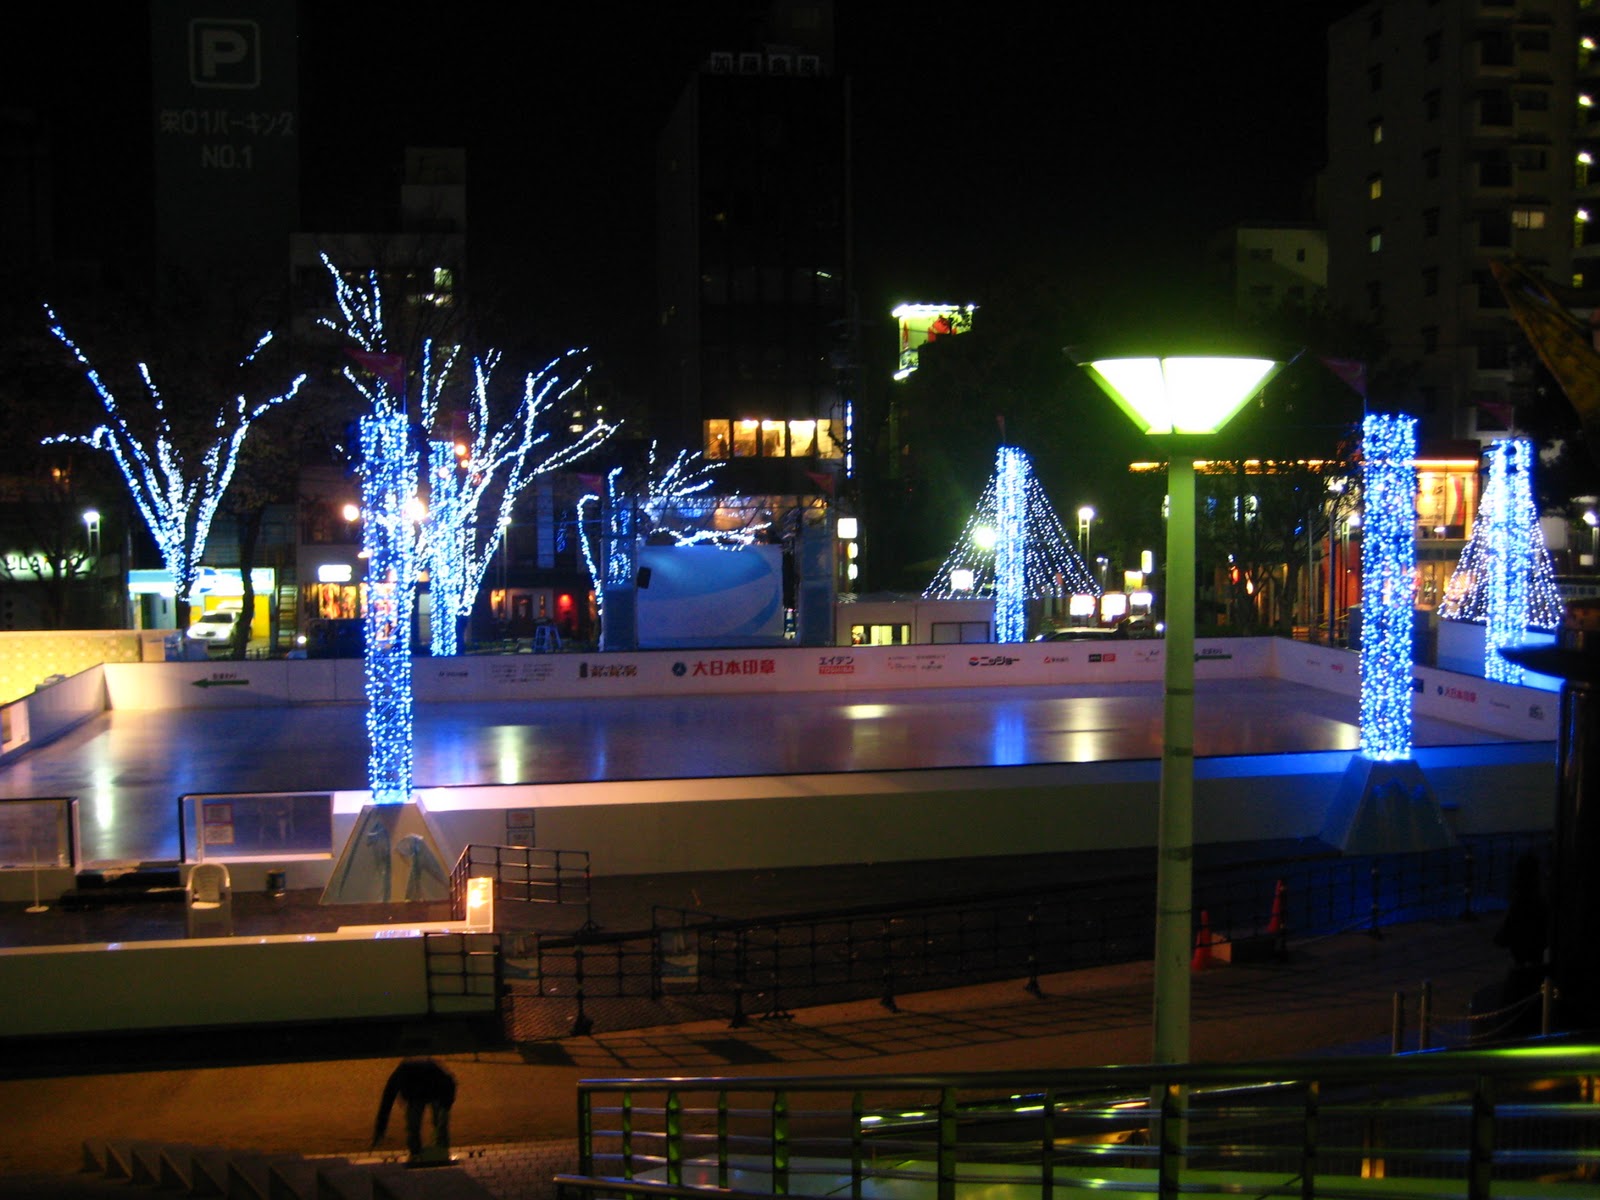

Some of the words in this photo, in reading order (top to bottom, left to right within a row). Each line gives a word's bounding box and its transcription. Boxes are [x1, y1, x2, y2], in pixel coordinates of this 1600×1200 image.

[201, 29, 248, 78] P
[201, 144, 254, 169] NO.1
[692, 659, 776, 677] 大日本印章
[980, 655, 1020, 667] ニッショー
